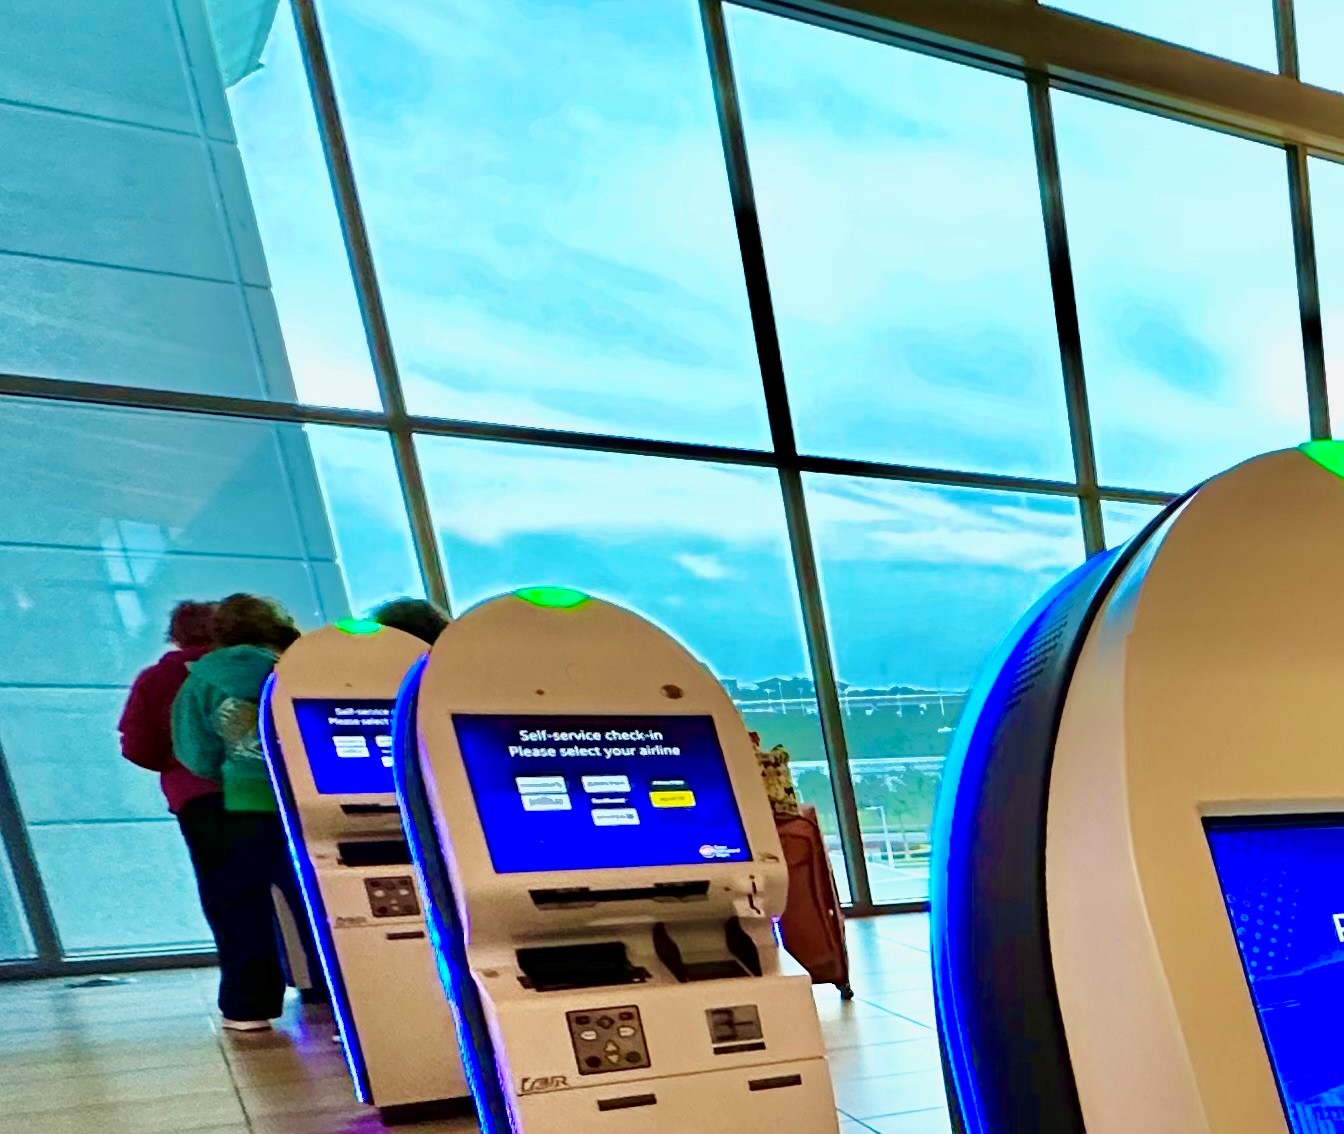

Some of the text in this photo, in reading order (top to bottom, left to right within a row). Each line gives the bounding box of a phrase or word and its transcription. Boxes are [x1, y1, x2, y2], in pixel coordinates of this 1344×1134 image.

[519, 730, 664, 741] Self-service check-in
[508, 745, 681, 759] Please select your airline
